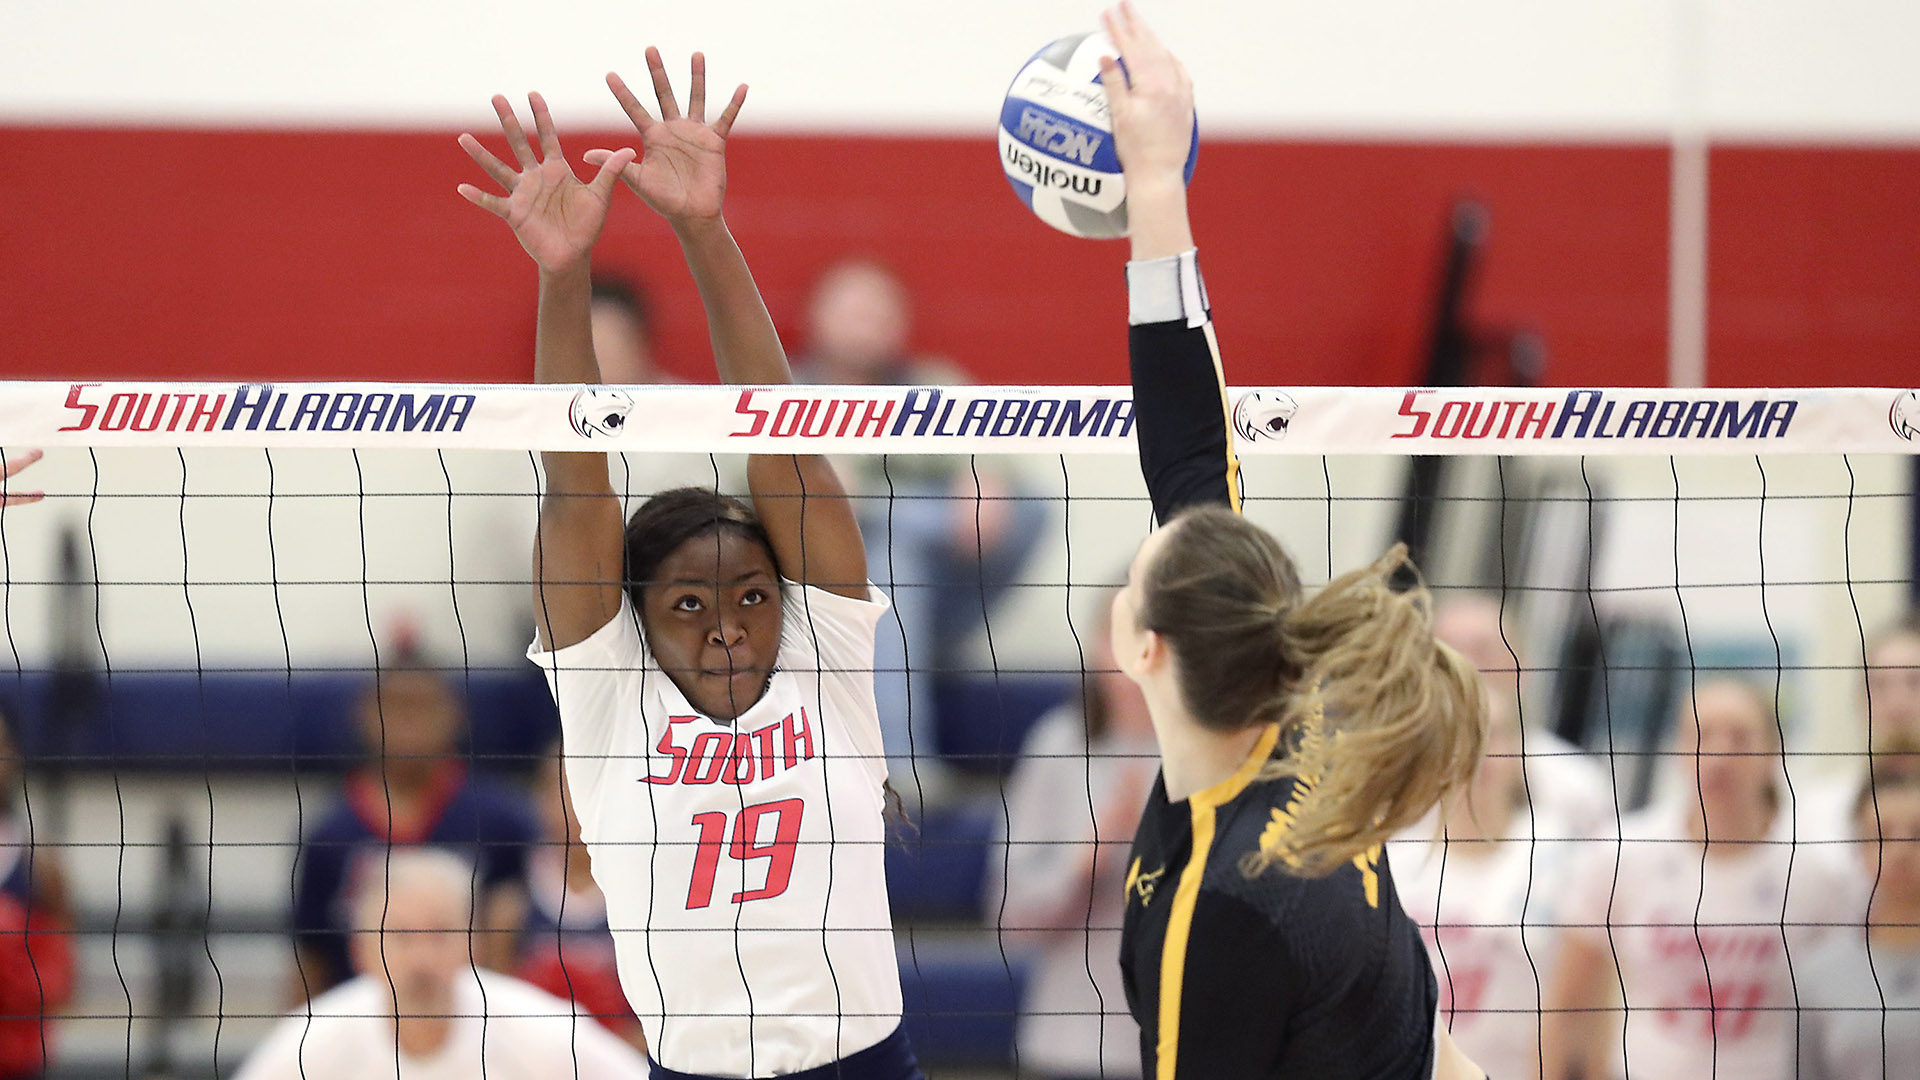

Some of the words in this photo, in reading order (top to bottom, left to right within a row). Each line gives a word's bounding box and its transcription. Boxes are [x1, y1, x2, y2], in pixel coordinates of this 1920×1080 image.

[1008, 143, 1102, 196] molten
[1014, 106, 1104, 166] NCAA
[637, 706, 815, 785] SOUTH
[685, 798, 804, 910] 19
